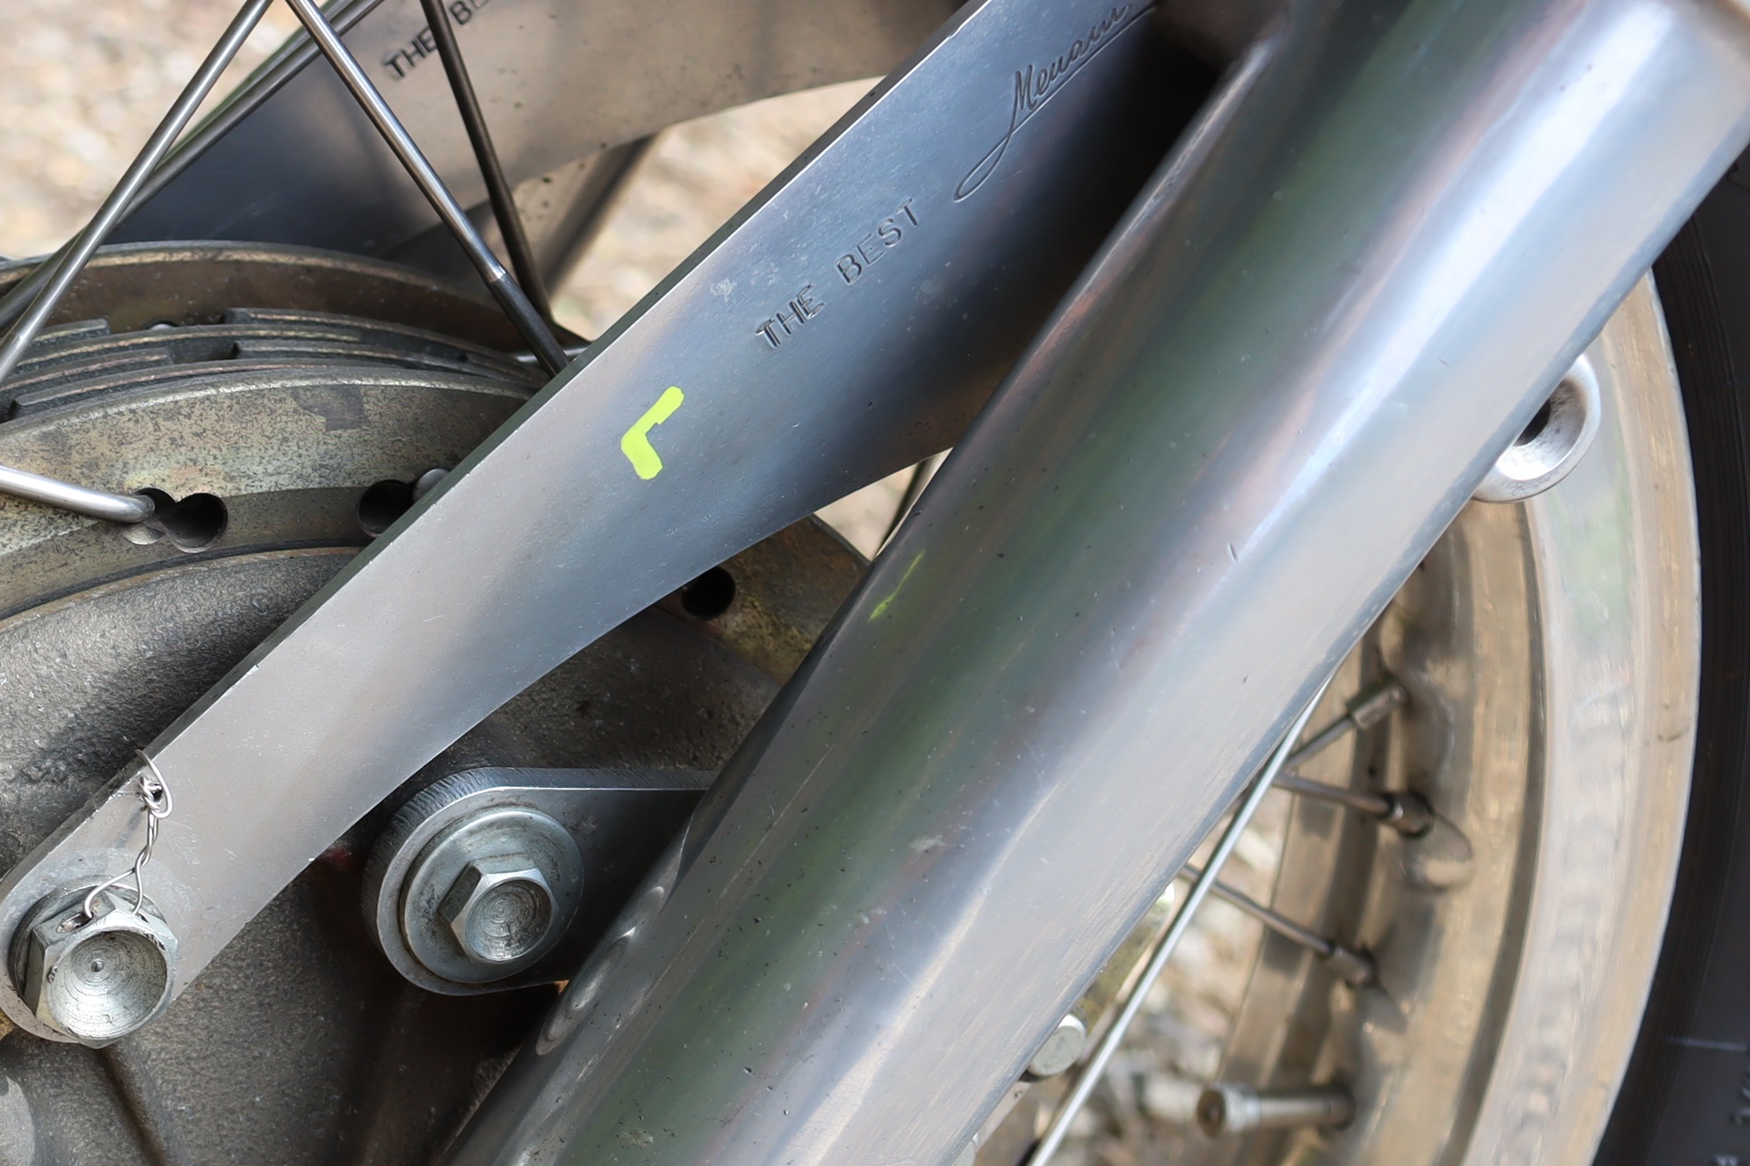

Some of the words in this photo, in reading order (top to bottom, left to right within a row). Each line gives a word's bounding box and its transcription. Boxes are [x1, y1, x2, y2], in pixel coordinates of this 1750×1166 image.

[383, 24, 438, 80] THE
[755, 283, 827, 349] THE
[836, 198, 921, 285] BEST
